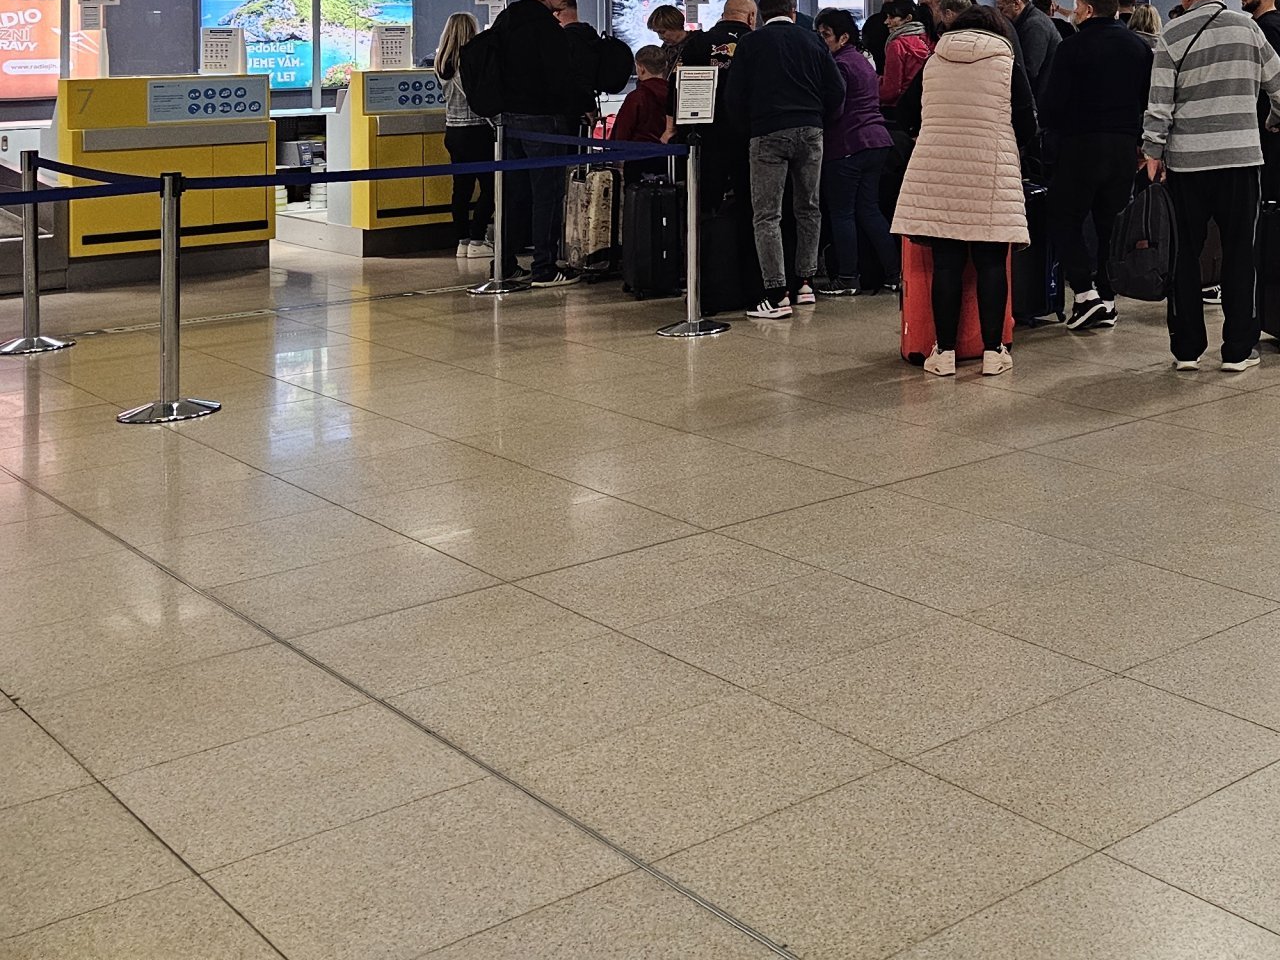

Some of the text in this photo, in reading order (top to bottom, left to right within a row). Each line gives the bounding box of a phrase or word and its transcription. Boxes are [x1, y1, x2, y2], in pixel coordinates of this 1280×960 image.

[0, 41, 38, 52] RAVY
[277, 71, 296, 83] LET
[77, 89, 93, 114] 7
